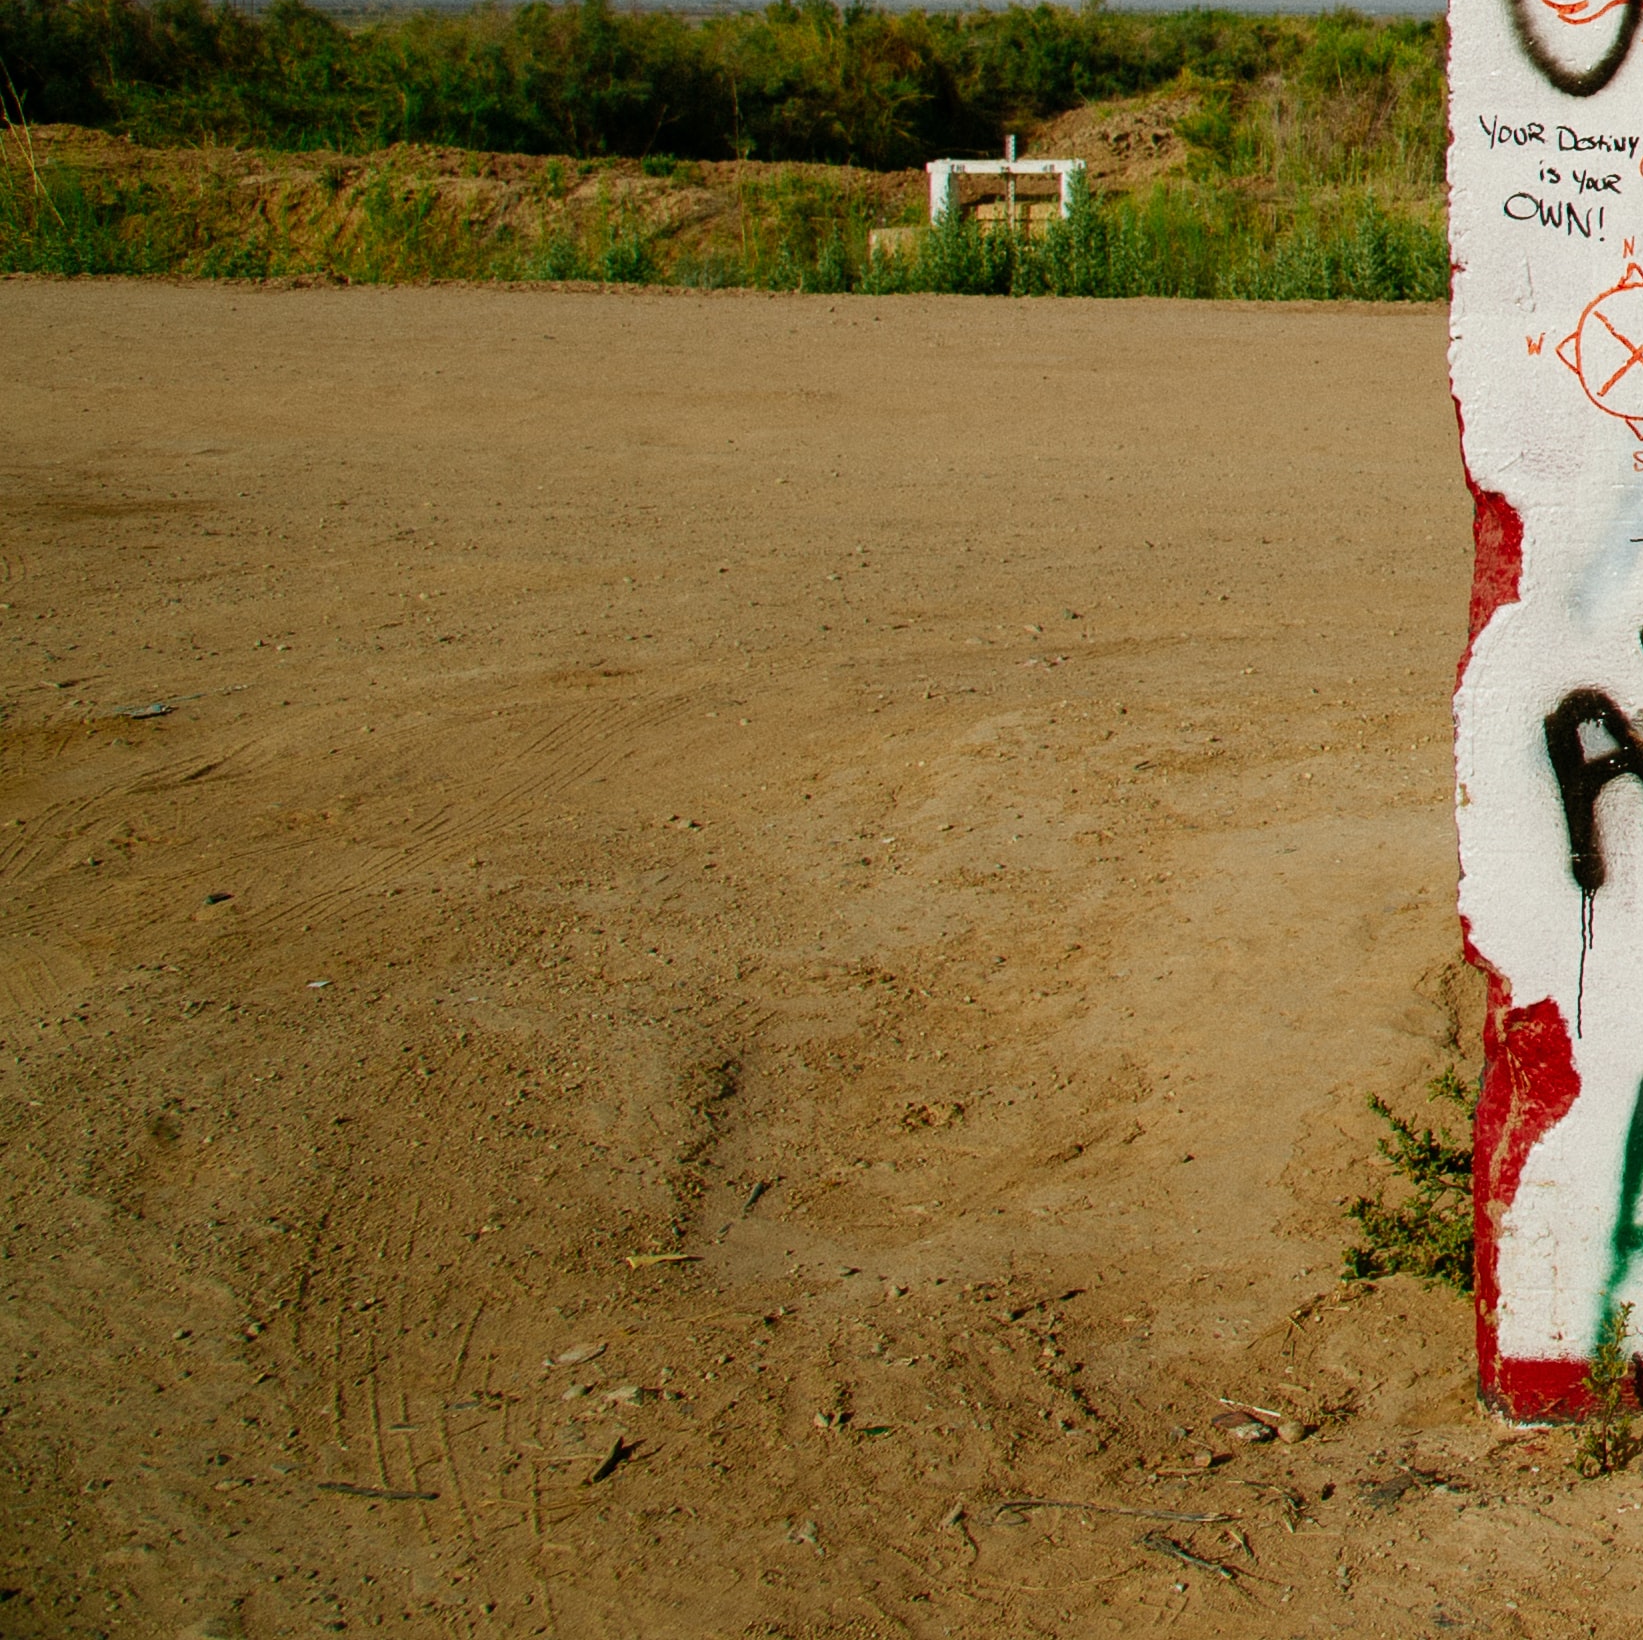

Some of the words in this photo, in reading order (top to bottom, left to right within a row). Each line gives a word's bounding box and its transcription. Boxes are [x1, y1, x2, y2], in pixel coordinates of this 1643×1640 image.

[1479, 115, 1546, 150] YOUR
[1539, 160, 1561, 184] is
[1503, 192, 1605, 242] OWN!
[1622, 235, 1636, 259] N
[1525, 331, 1546, 356] W
